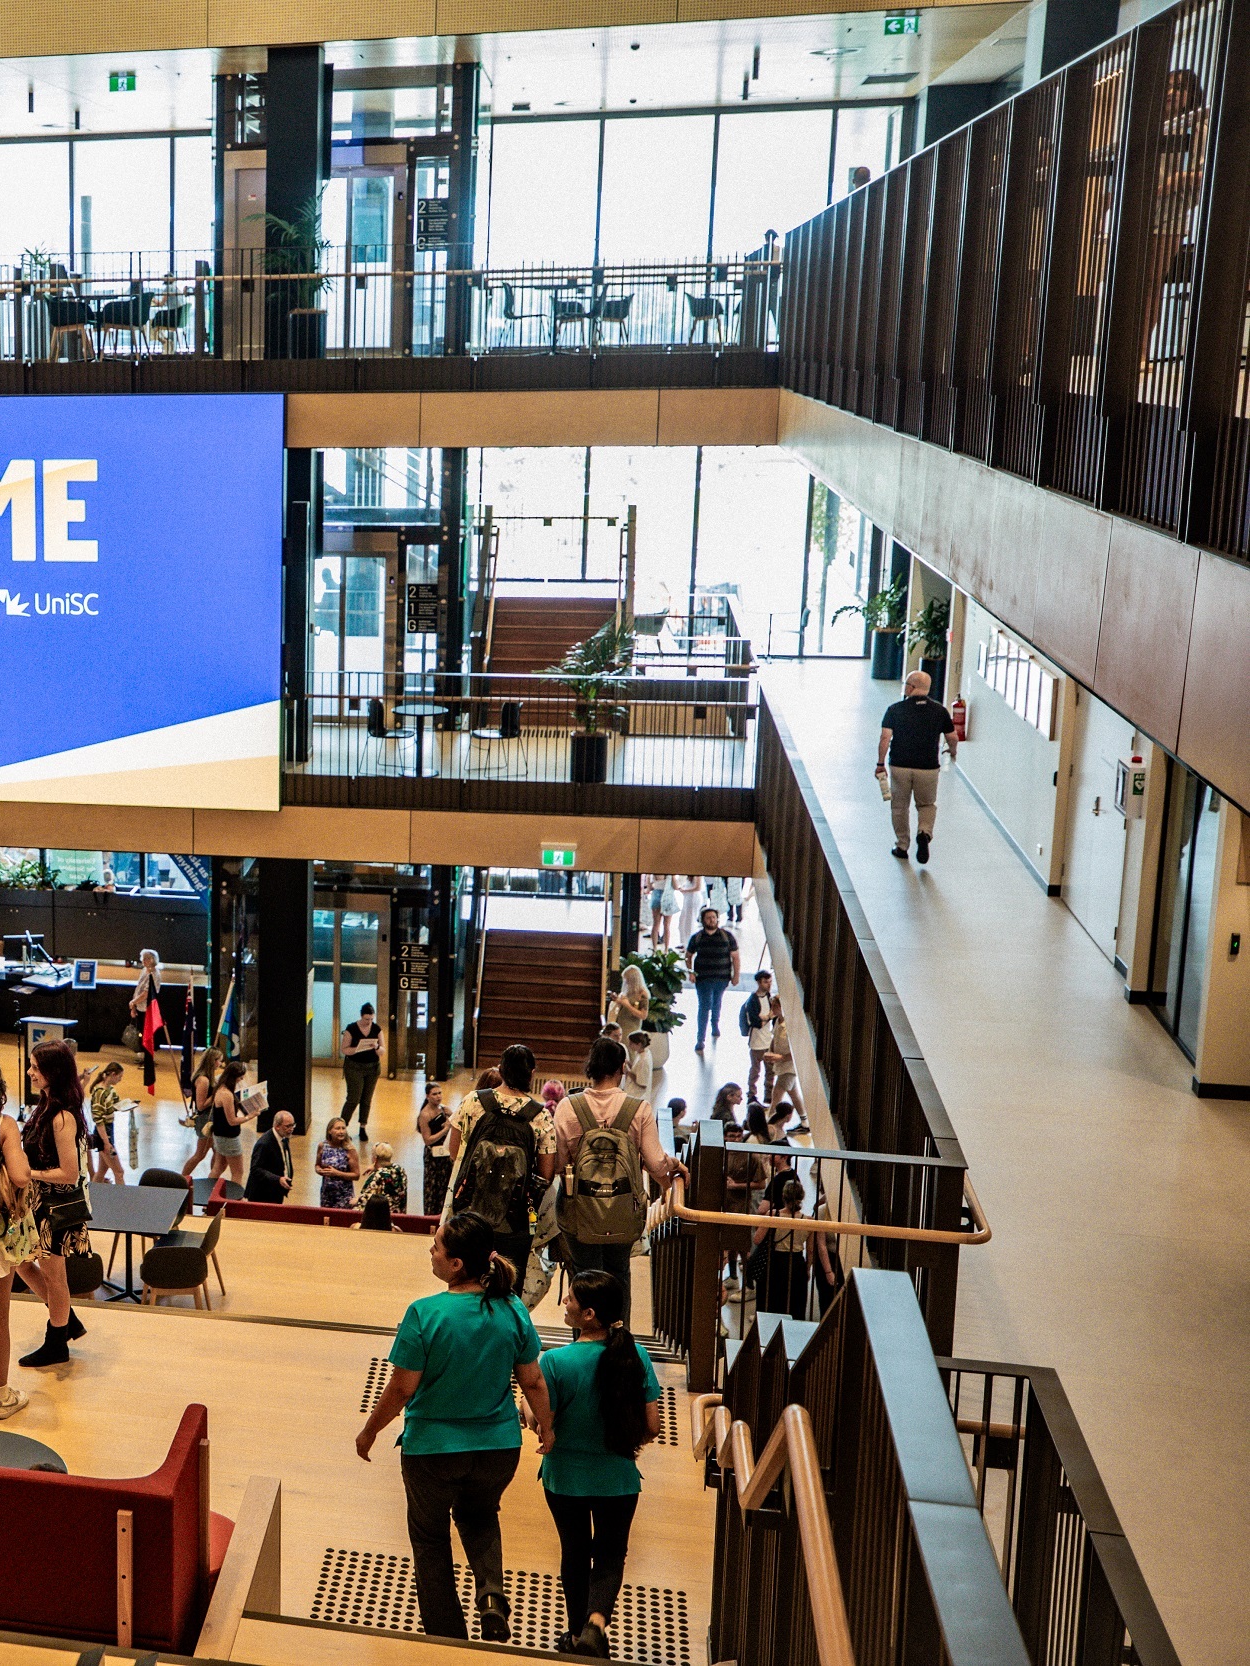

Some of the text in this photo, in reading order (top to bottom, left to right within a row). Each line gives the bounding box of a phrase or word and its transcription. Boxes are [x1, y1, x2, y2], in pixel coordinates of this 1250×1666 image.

[418, 200, 427, 214] 2
[419, 218, 425, 232] 1
[408, 585, 417, 598] 2
[34, 590, 99, 616] UniSC
[409, 602, 415, 615] 1
[407, 619, 417, 632] G
[199, 867, 209, 880] us
[401, 945, 409, 957] 2
[402, 961, 407, 973] 1
[400, 976, 409, 989] G
